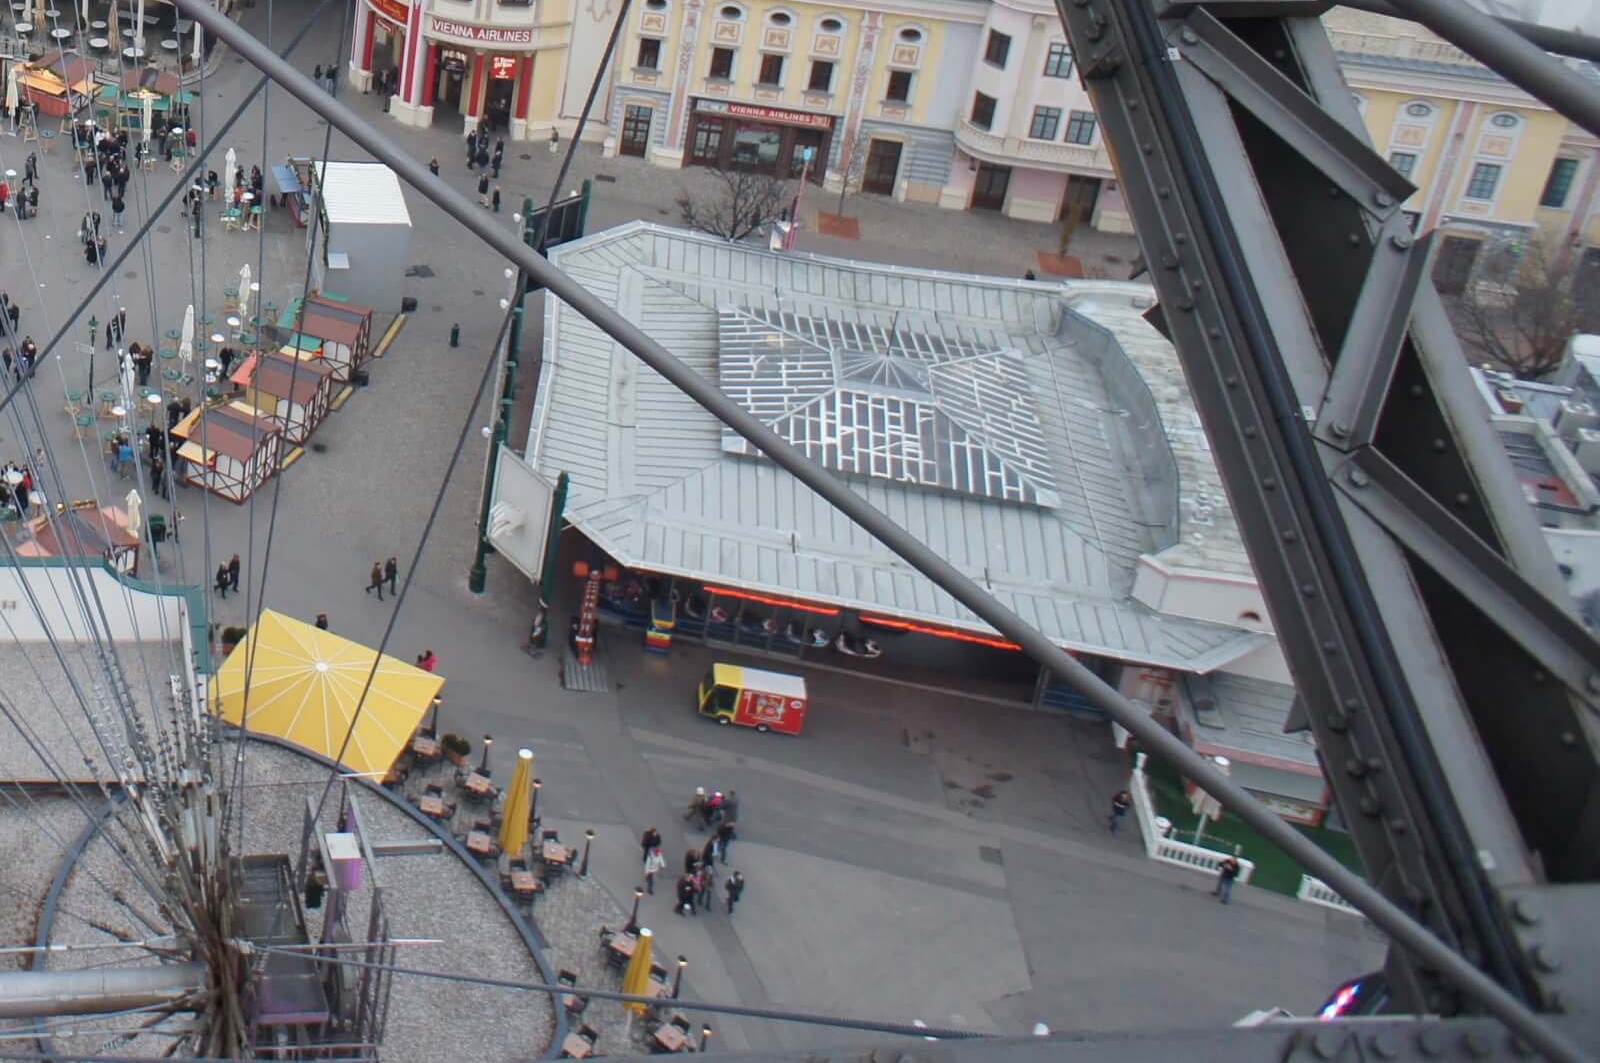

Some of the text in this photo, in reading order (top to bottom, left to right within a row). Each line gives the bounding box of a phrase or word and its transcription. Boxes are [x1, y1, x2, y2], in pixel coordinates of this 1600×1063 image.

[433, 19, 530, 42] VIENNA AIRLINES
[731, 105, 765, 116] VIENNA
[768, 110, 811, 122] AIRLINES
